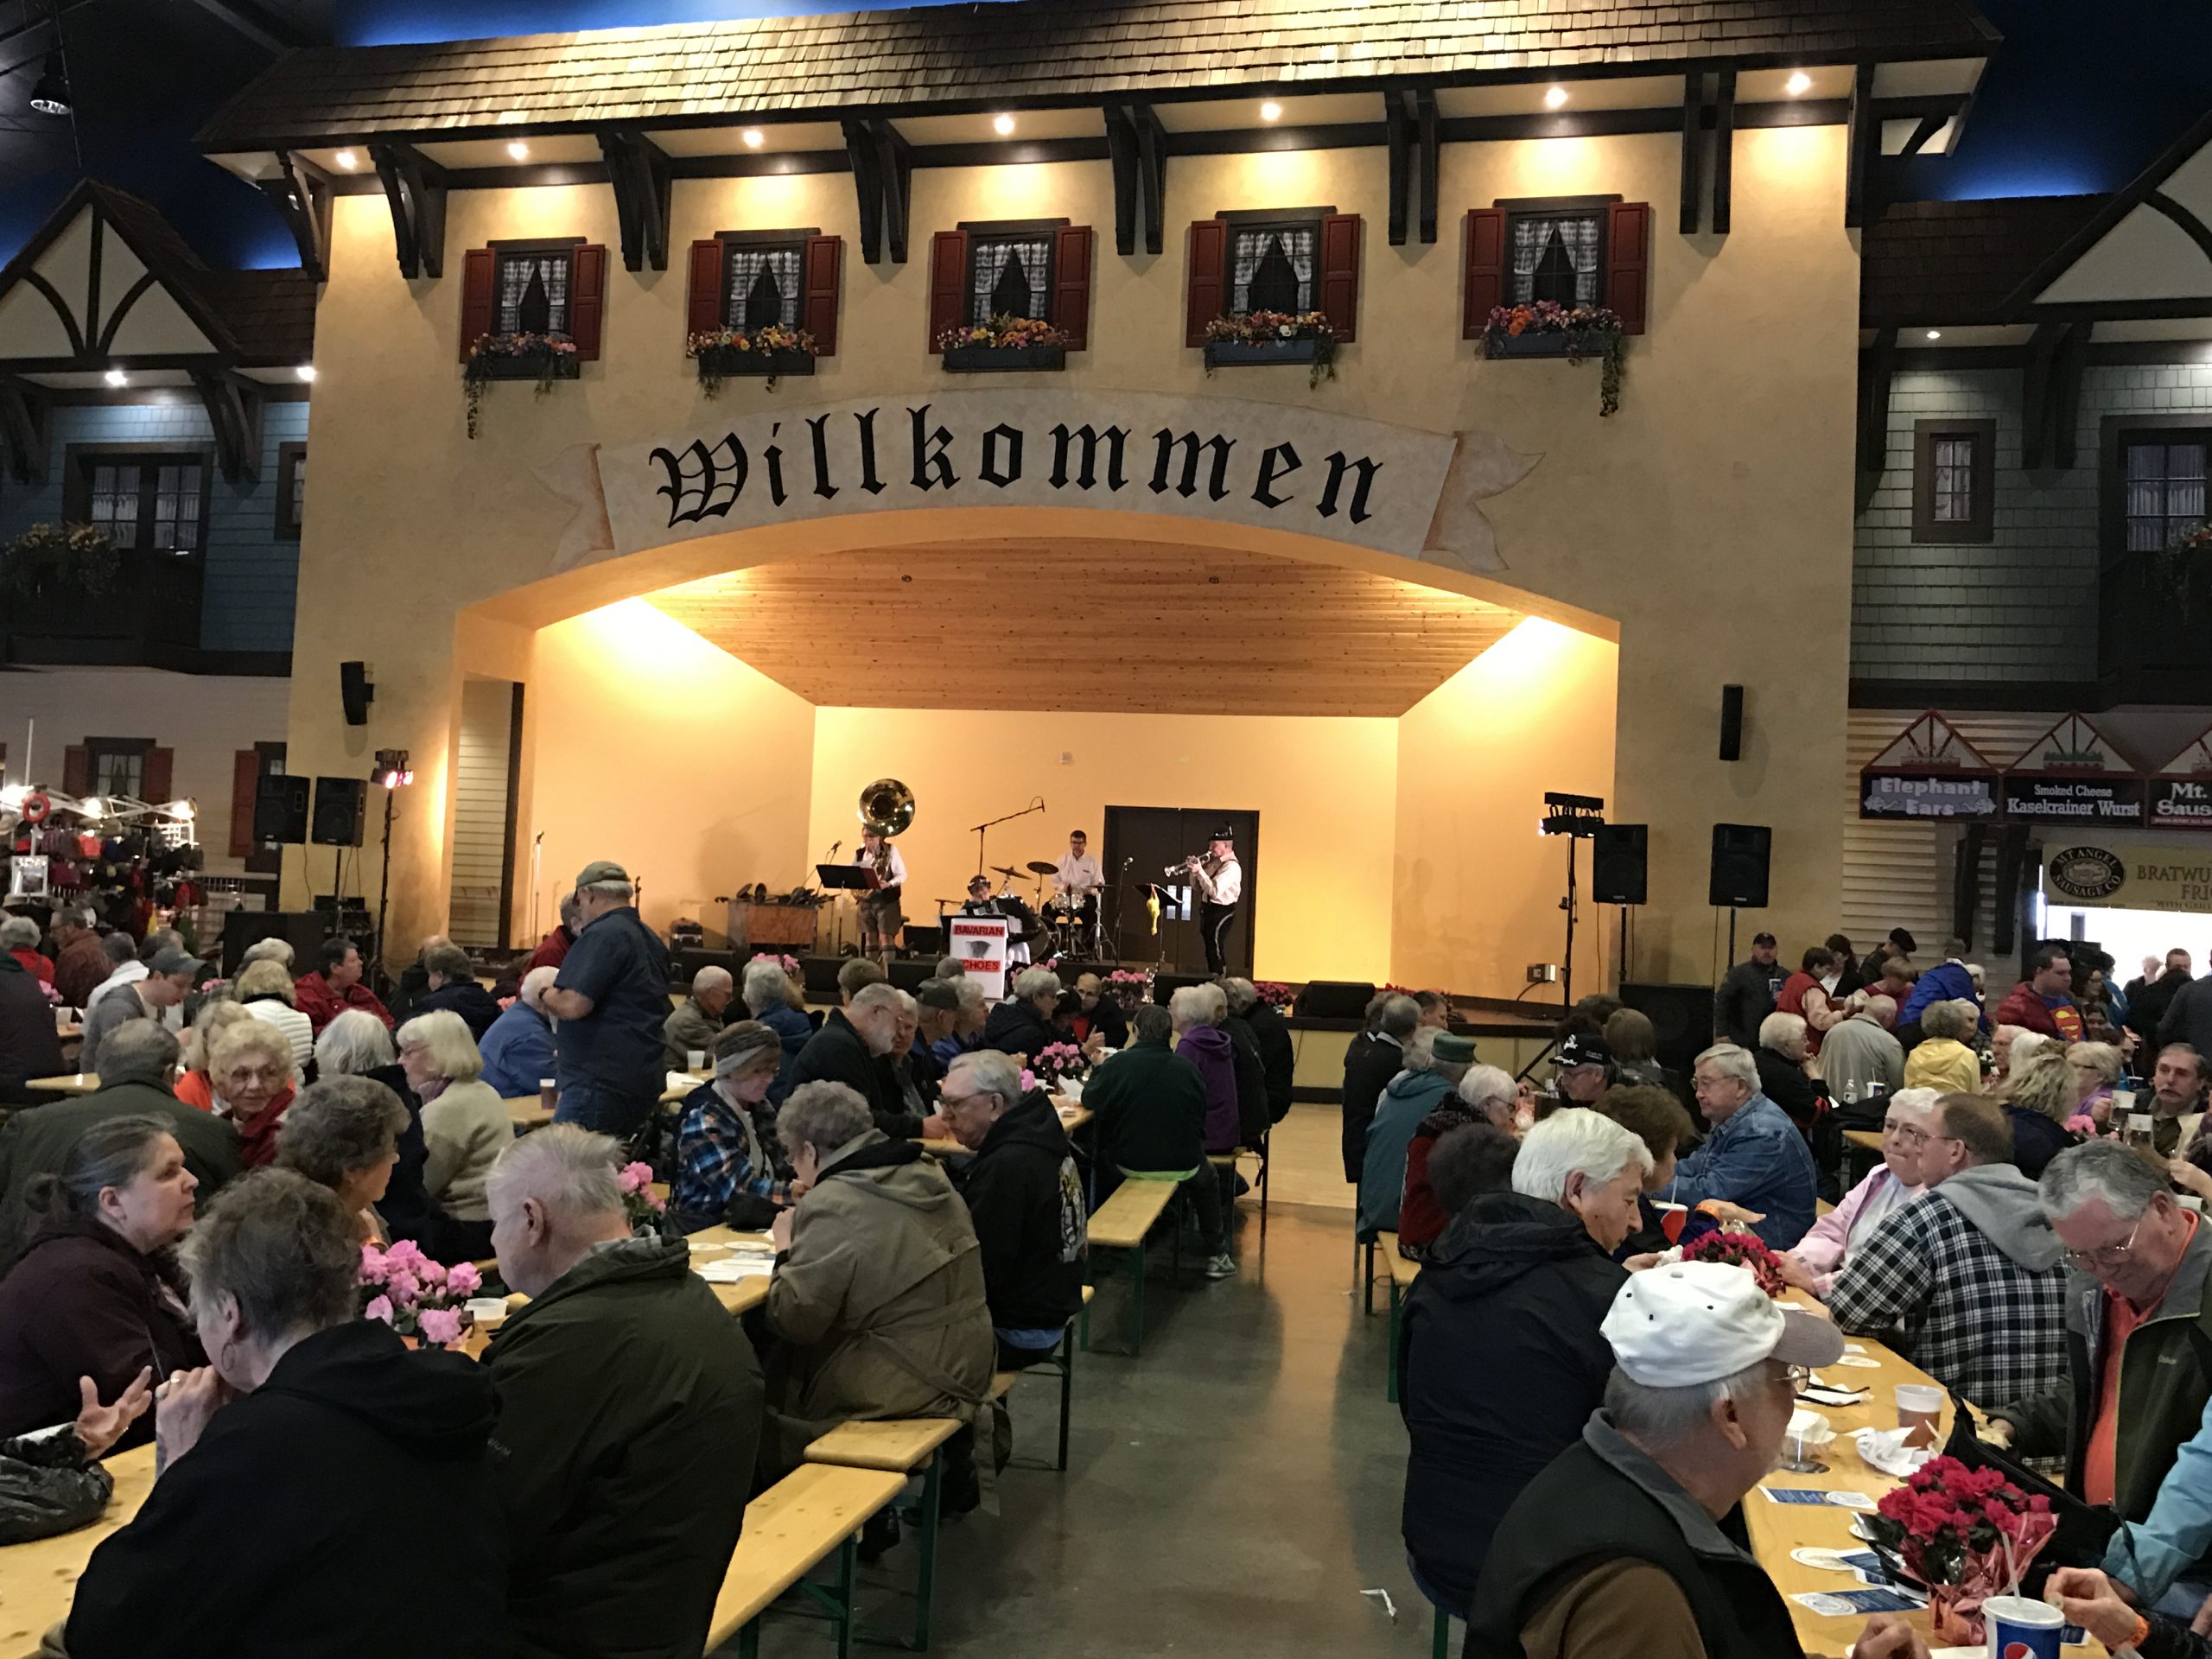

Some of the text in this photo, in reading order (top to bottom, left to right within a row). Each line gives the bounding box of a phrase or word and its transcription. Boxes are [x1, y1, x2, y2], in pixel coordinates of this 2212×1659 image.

[649, 404, 1383, 528] Willkommen
[1880, 778, 1981, 797] Elephant
[2034, 784, 2113, 797] Smoked Cheese
[2171, 782, 2208, 802] Mt.
[1905, 798, 1955, 816] Ears
[2006, 798, 2140, 817] Kasekrainer Wurst
[2056, 849, 2117, 866] MT ANGEL
[2056, 874, 2103, 896] SAUSAGE
[2181, 884, 2212, 900] FRI
[955, 925, 1003, 936] BAVARIAN
[962, 960, 1000, 970] CHOES
